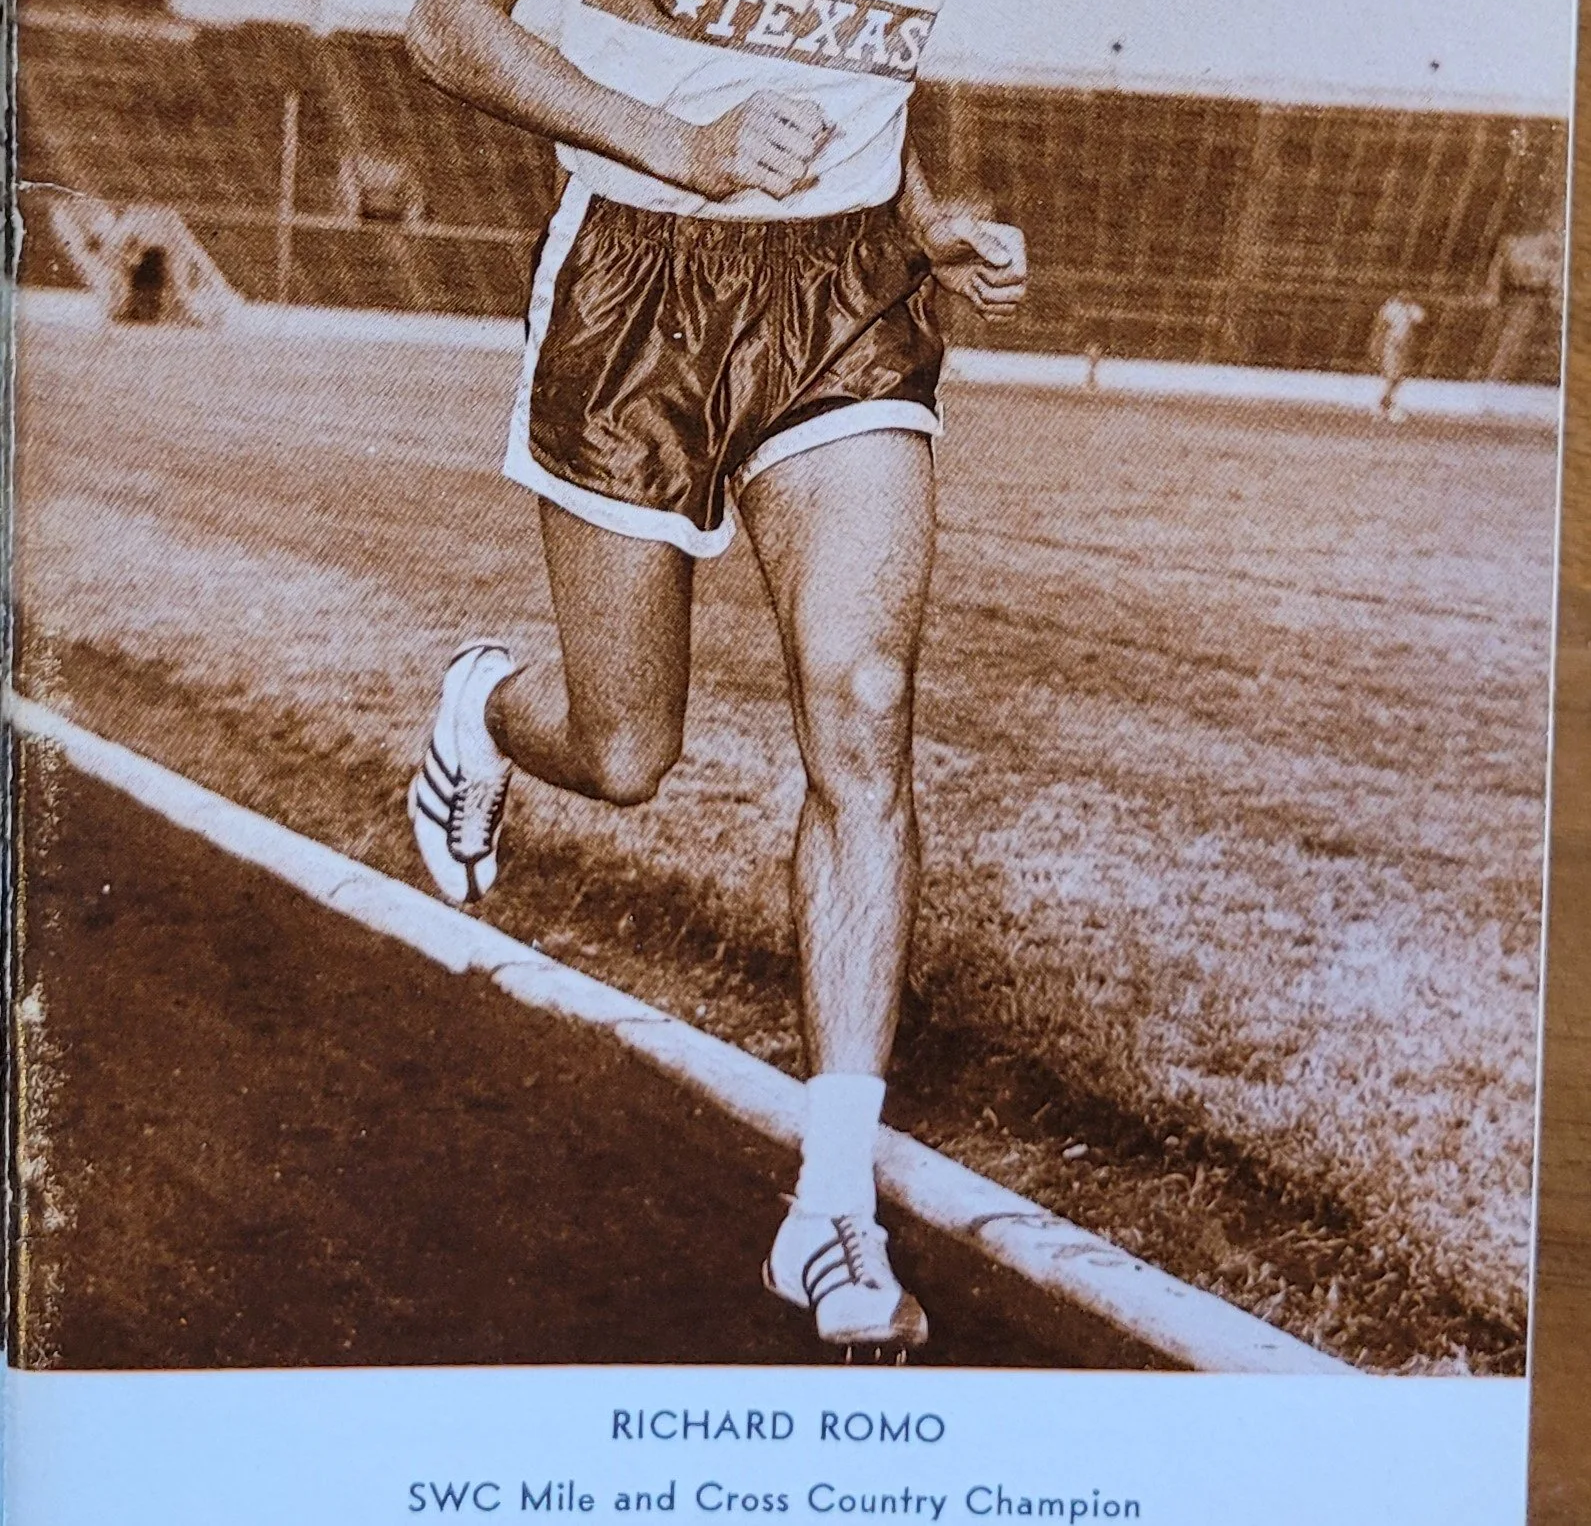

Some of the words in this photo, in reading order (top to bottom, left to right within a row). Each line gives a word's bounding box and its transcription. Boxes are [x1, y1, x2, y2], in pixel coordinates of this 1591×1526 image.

[611, 1409, 795, 1442] RICHARD
[819, 1411, 946, 1443] ROMO
[408, 1482, 501, 1513] SWC
[520, 1480, 595, 1513] Mile
[613, 1480, 675, 1513] and
[695, 1483, 789, 1513] Cross
[808, 1484, 948, 1520] Country
[965, 1485, 1141, 1524] Champion
